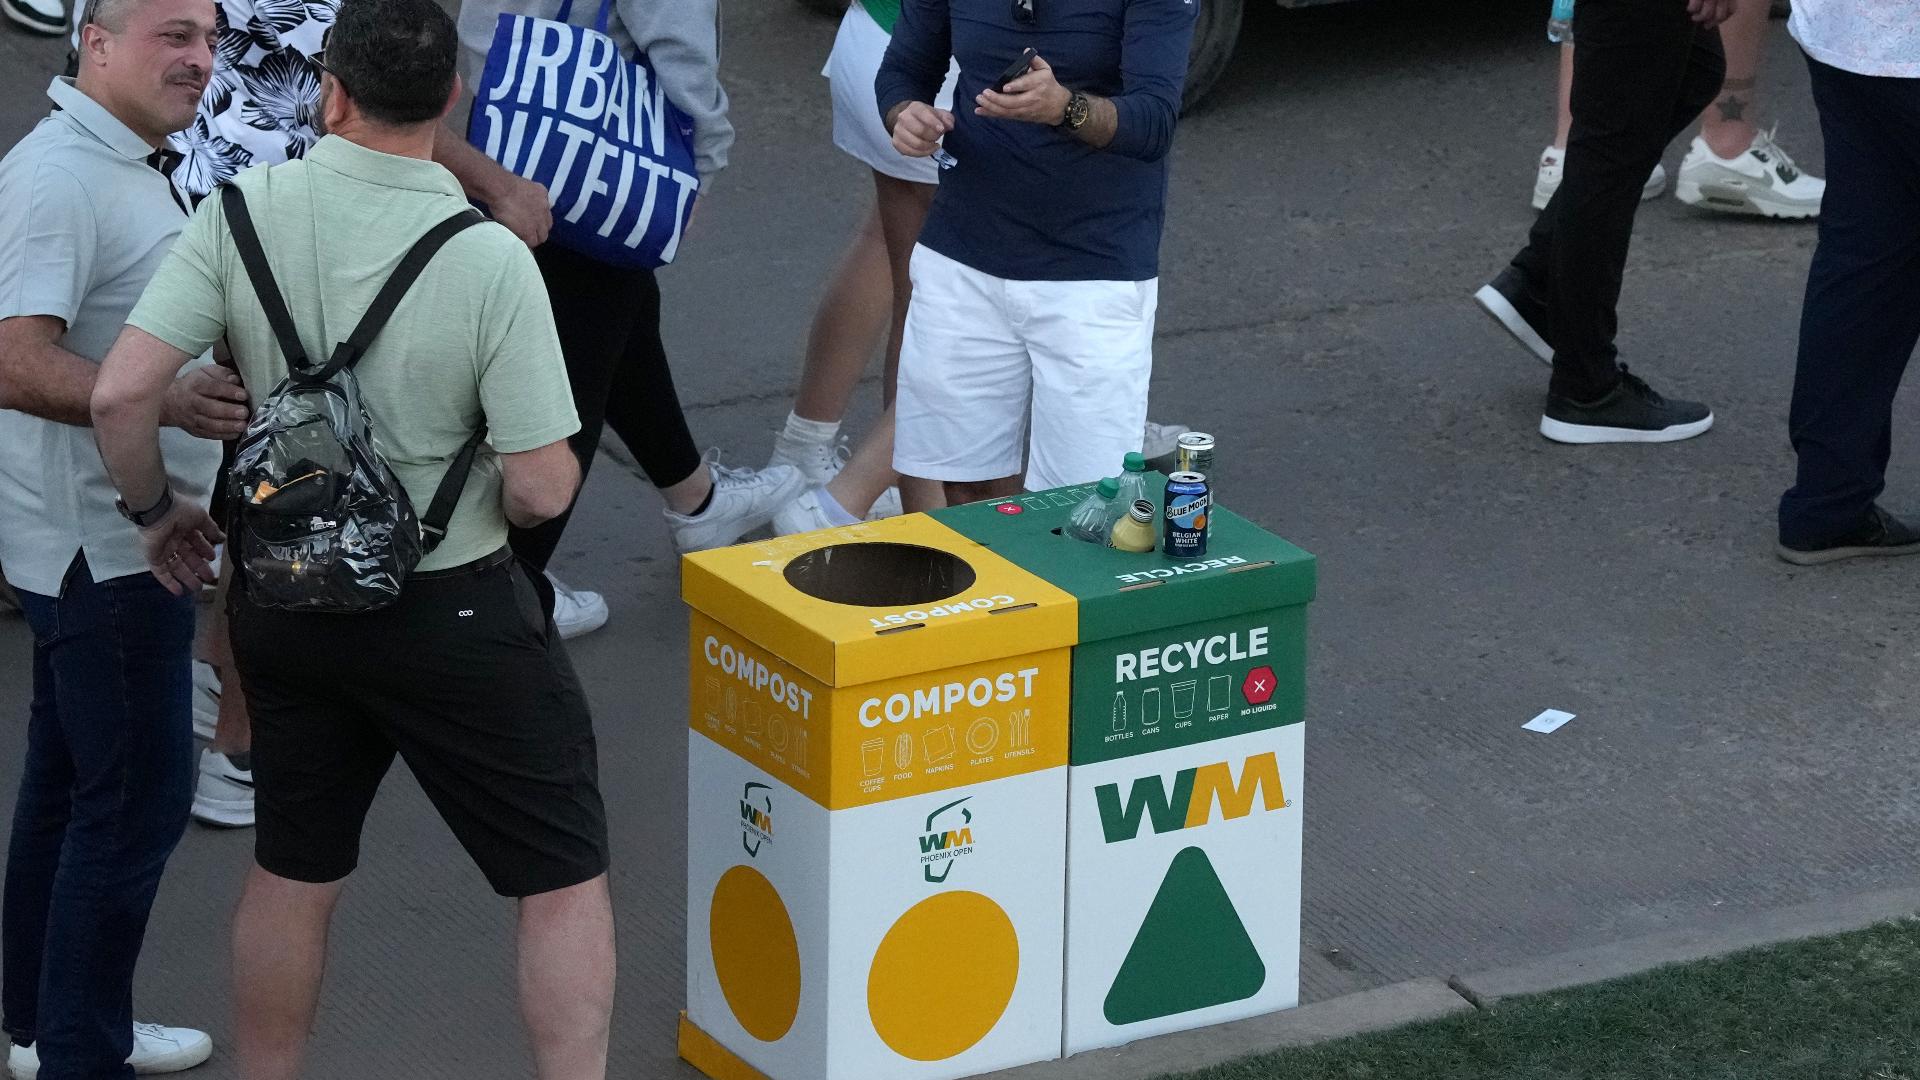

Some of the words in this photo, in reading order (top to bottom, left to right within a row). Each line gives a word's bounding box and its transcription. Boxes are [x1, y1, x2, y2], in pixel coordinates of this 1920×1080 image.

[1167, 506, 1187, 518] BLUE
[1172, 531, 1201, 539] BELGIAN
[1115, 555, 1248, 583] RECYCLE
[869, 595, 1015, 628] COMPOST
[1115, 626, 1269, 683] RECYCLE
[704, 635, 813, 720] COMPOST
[858, 668, 1039, 728] COMPOST
[1240, 708, 1251, 717] NO
[1251, 703, 1277, 715] LIQUIDS
[1208, 713, 1229, 722] PAPER
[1174, 720, 1192, 729] CUPS
[1104, 731, 1134, 742] BOTTLES
[1141, 726, 1160, 736] CANS
[1004, 748, 1035, 759] UTENSILS
[970, 756, 994, 766] PLATES
[925, 764, 954, 775] NAPKINS
[859, 776, 885, 787] COFFEE
[893, 772, 913, 781] FOOD
[863, 785, 881, 793] CUPS
[919, 827, 973, 853] WM
[920, 851, 952, 864] PHOENIX
[953, 846, 973, 857] OPEN
